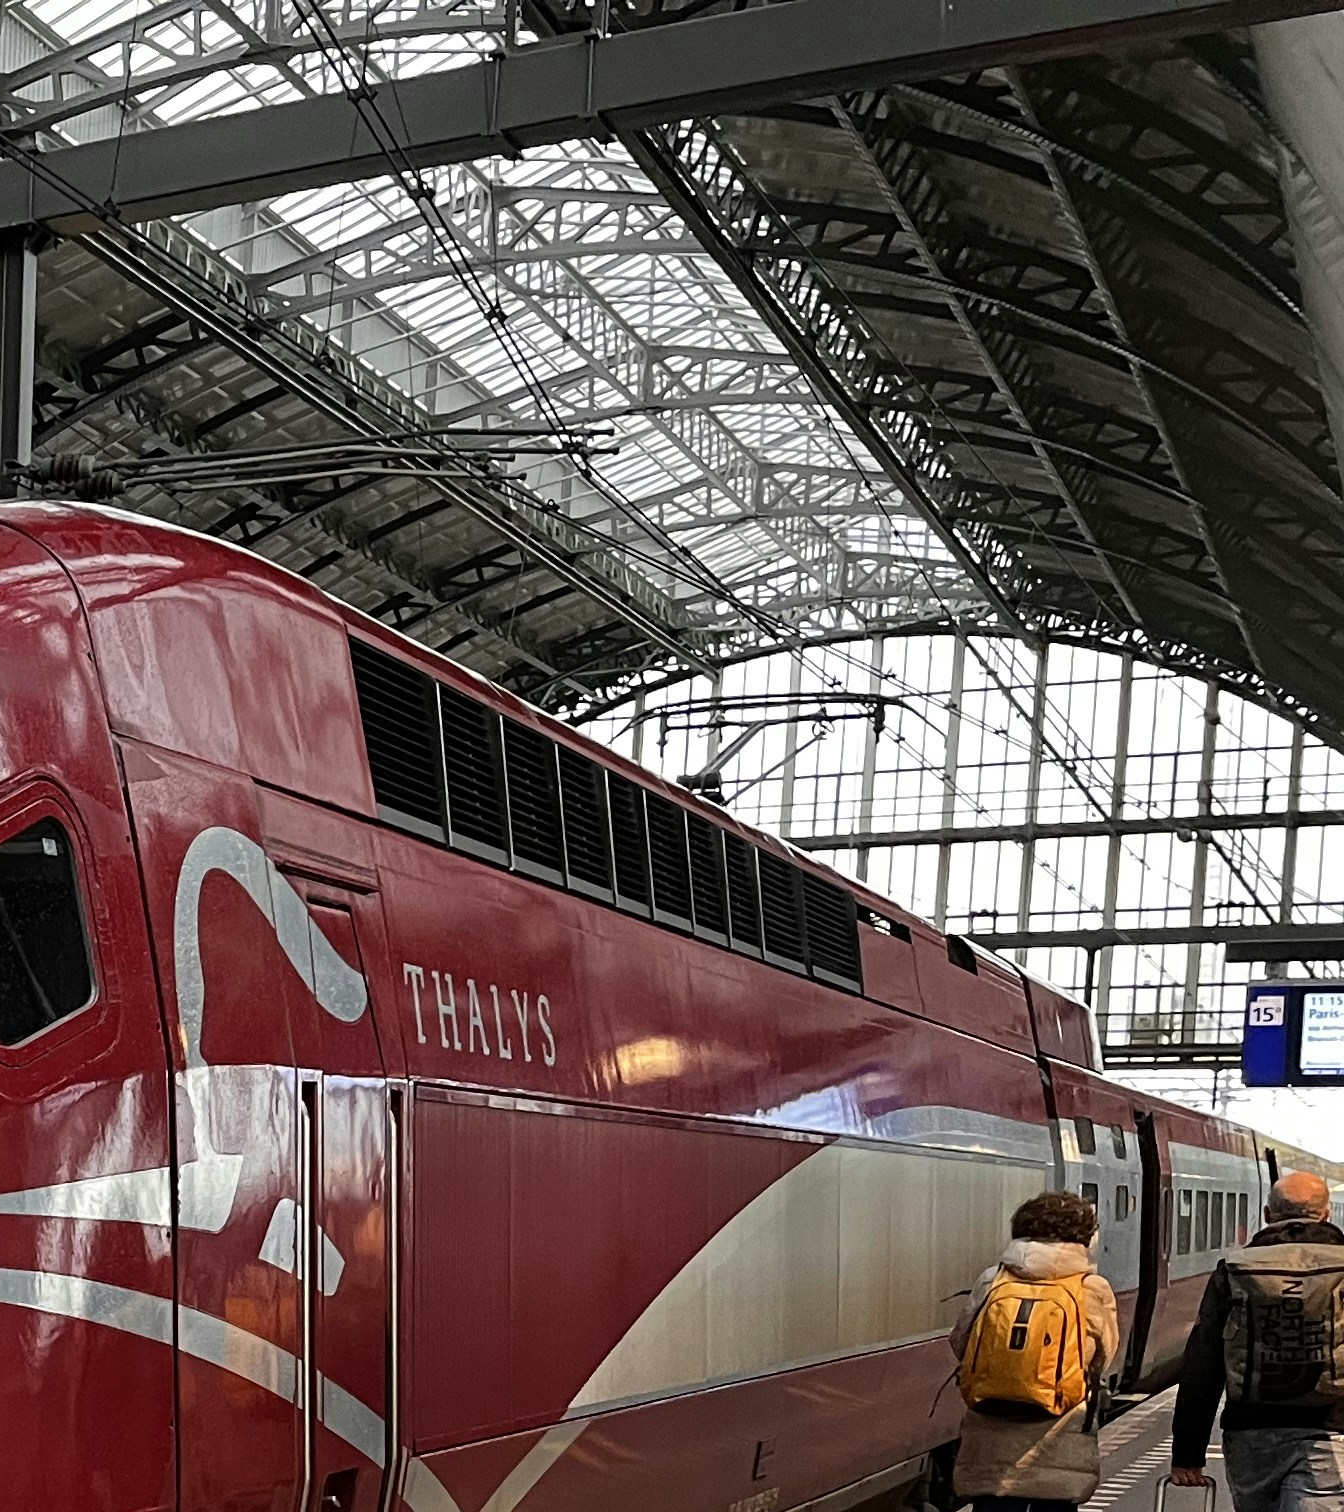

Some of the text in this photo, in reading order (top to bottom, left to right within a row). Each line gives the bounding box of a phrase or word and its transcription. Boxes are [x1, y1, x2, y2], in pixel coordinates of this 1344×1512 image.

[403, 962, 556, 1067] THALYS
[1281, 1280, 1304, 1361] NORTH
[1304, 1315, 1326, 1360] THE
